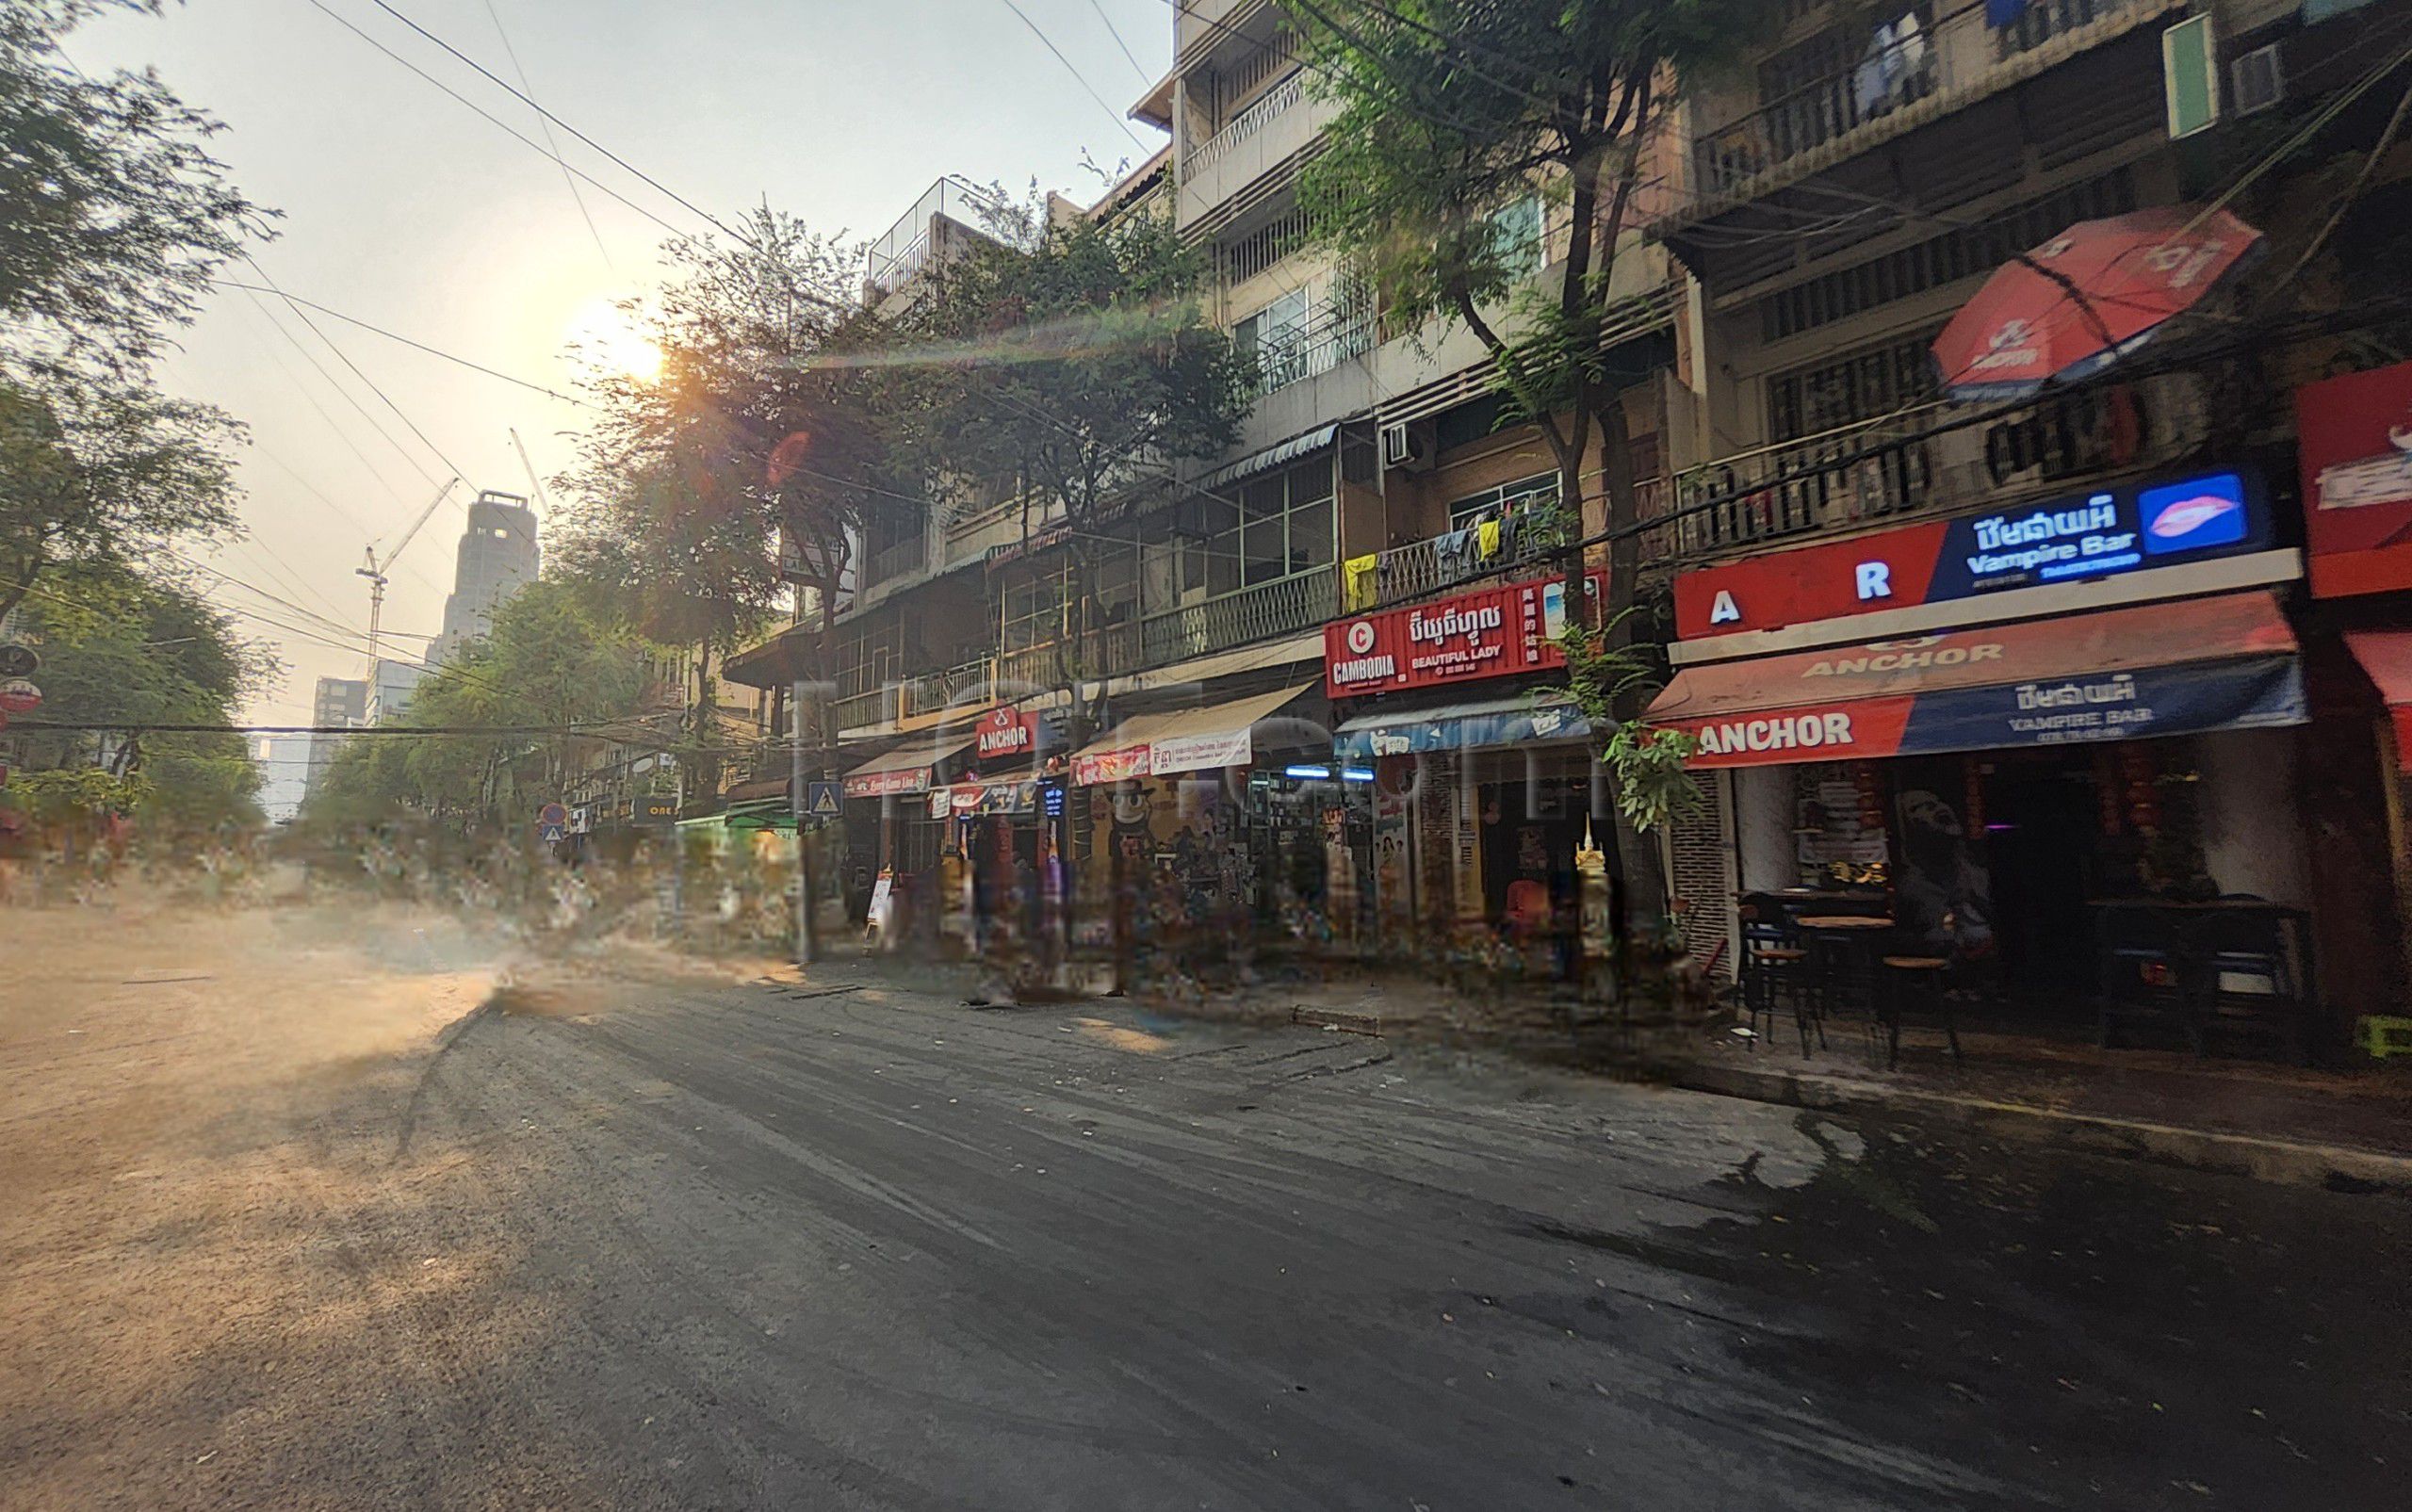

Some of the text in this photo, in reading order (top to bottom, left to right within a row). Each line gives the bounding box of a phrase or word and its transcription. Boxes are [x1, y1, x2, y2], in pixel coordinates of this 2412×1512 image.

[1966, 543, 2078, 575] Vampire
[2080, 532, 2137, 556] Bar
[1333, 655, 1395, 685] CAMBODIA
[1411, 651, 1470, 670] BEAUTIFUL
[1471, 644, 1502, 660] LADY
[1801, 643, 2004, 679] ANCHOR
[1698, 712, 1852, 756] ANCHOR
[2008, 712, 2103, 732] VAMPIRE
[979, 726, 1028, 752] ANCHOR
